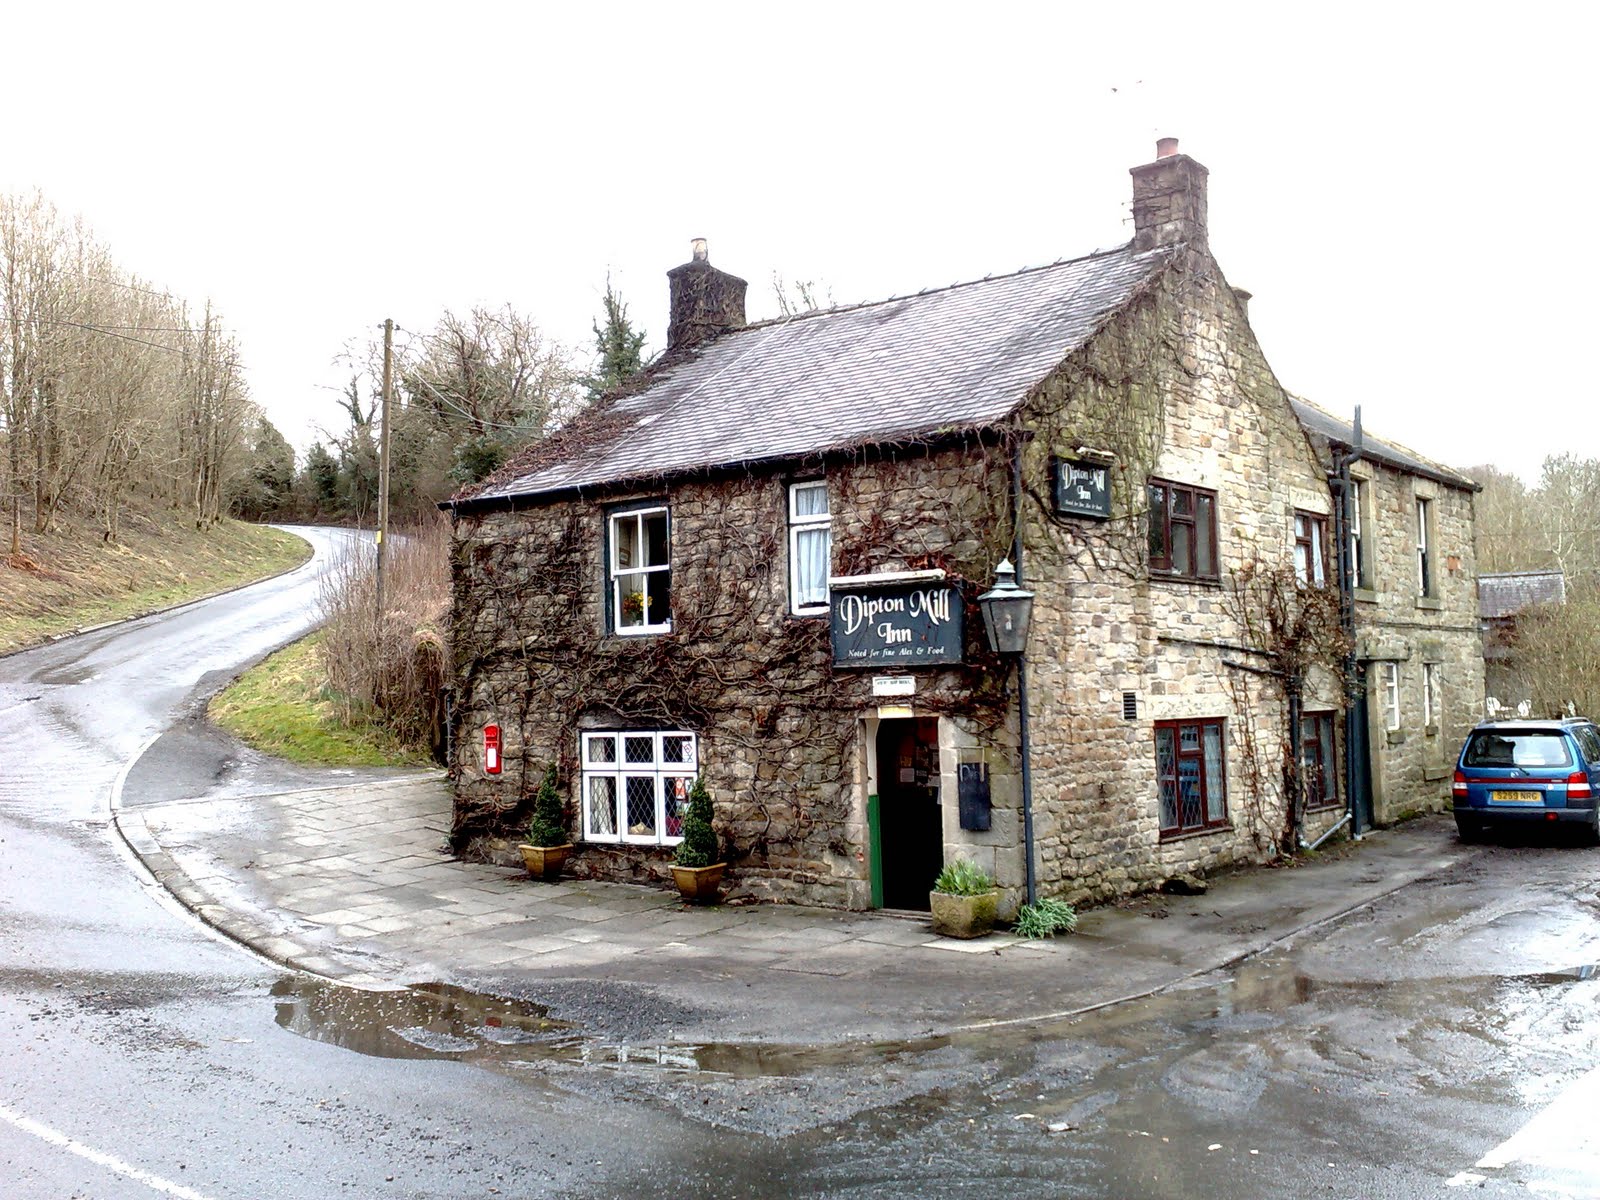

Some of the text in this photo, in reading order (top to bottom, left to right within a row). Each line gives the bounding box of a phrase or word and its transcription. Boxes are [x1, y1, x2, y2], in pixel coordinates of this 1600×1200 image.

[1062, 463, 1105, 492] Dipton Mill
[1077, 485, 1091, 500] Inn
[840, 588, 951, 635] Dipton Mill
[877, 622, 912, 644] Inn
[848, 648, 867, 657] Noted
[869, 648, 880, 658] for
[882, 647, 895, 658] fine
[916, 646, 924, 655] &
[927, 646, 945, 655] Food
